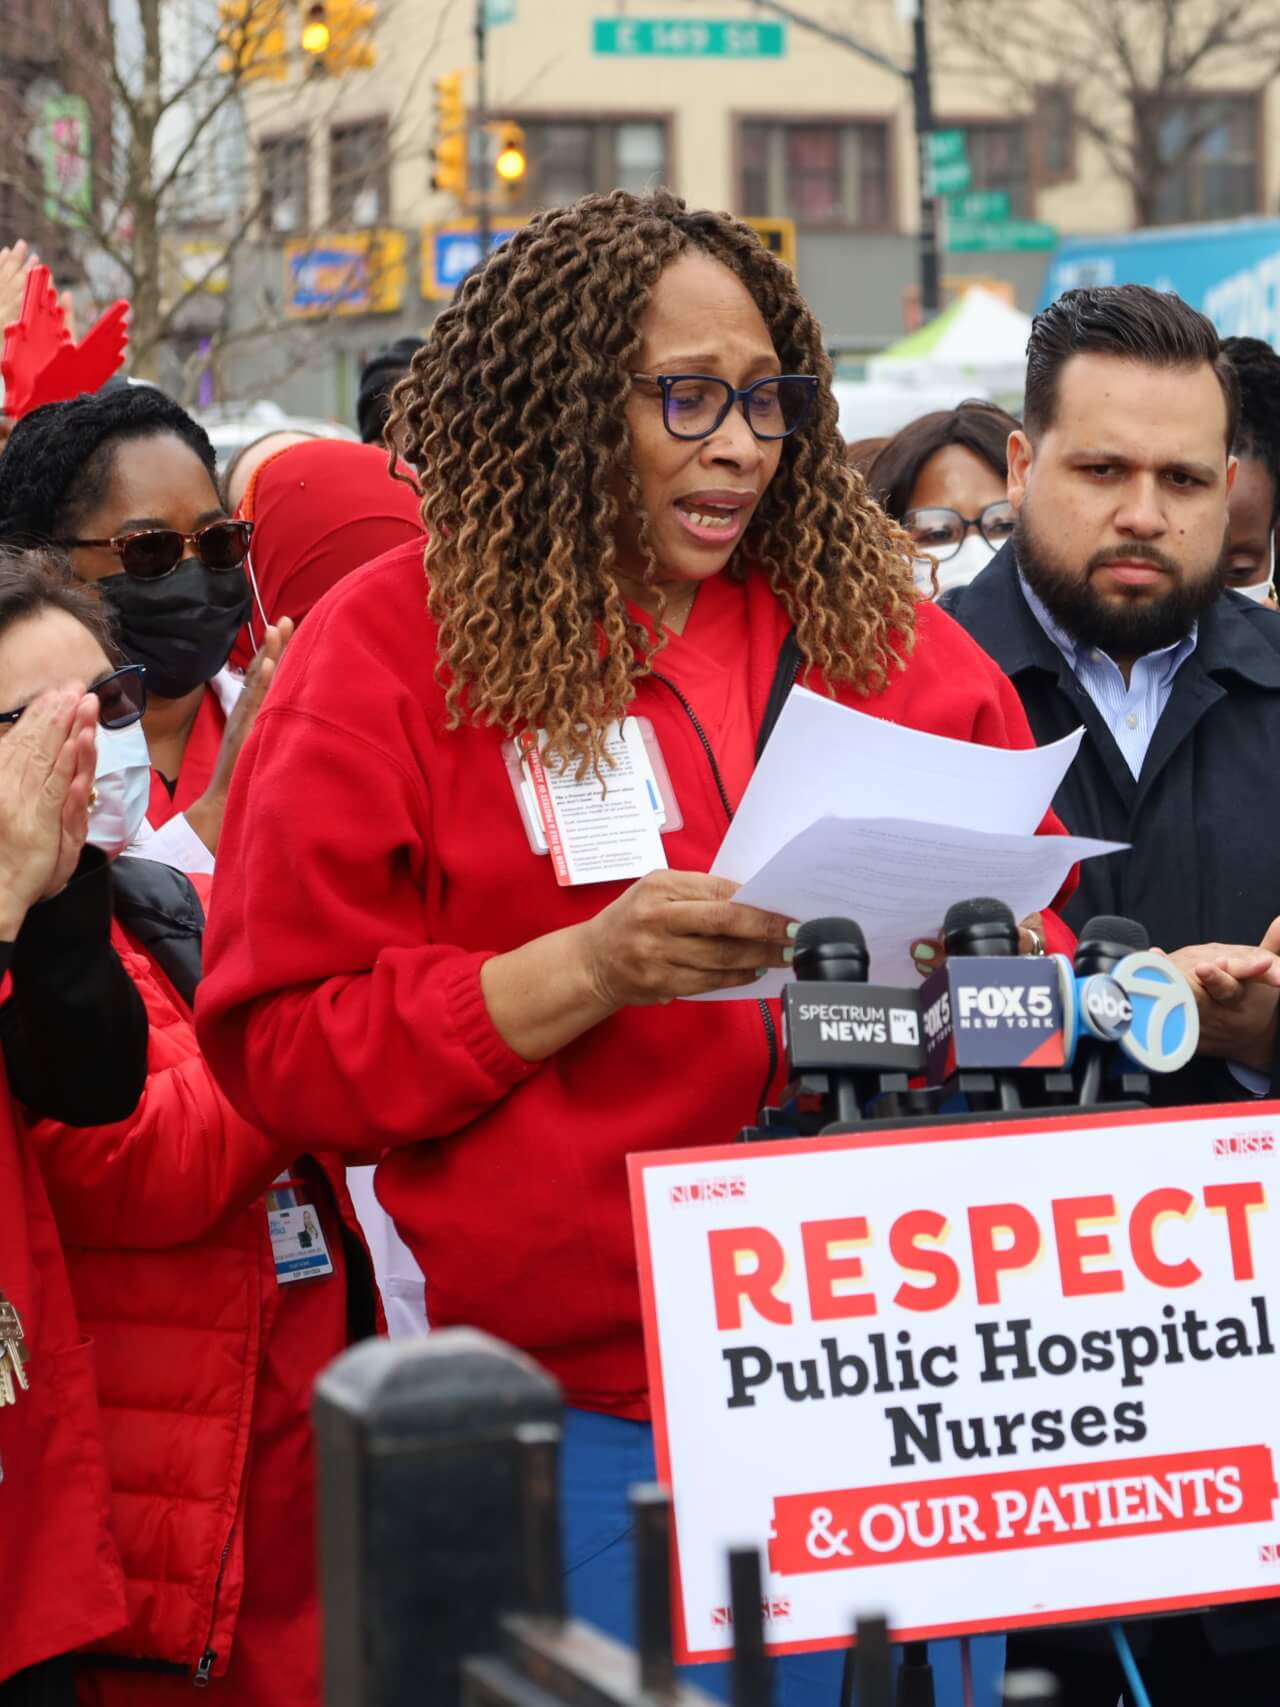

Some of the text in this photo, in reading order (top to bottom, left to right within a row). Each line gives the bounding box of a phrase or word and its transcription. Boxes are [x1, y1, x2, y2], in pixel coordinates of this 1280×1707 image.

[616, 22, 637, 52] E
[799, 1004, 885, 1022] SPECTRUM
[1087, 988, 1133, 1022] abc
[820, 1022, 887, 1043] NEWS
[908, 1026, 915, 1041] 1
[960, 1018, 1054, 1029] NEW YORK
[1215, 1135, 1276, 1157] NURSES
[671, 1177, 747, 1204] NURSES
[707, 1181, 1268, 1331] RESPECT
[723, 1296, 1275, 1408] Public Hospital
[885, 1400, 1148, 1468] Nurses
[804, 1465, 1244, 1560] & OUR PATIENTS
